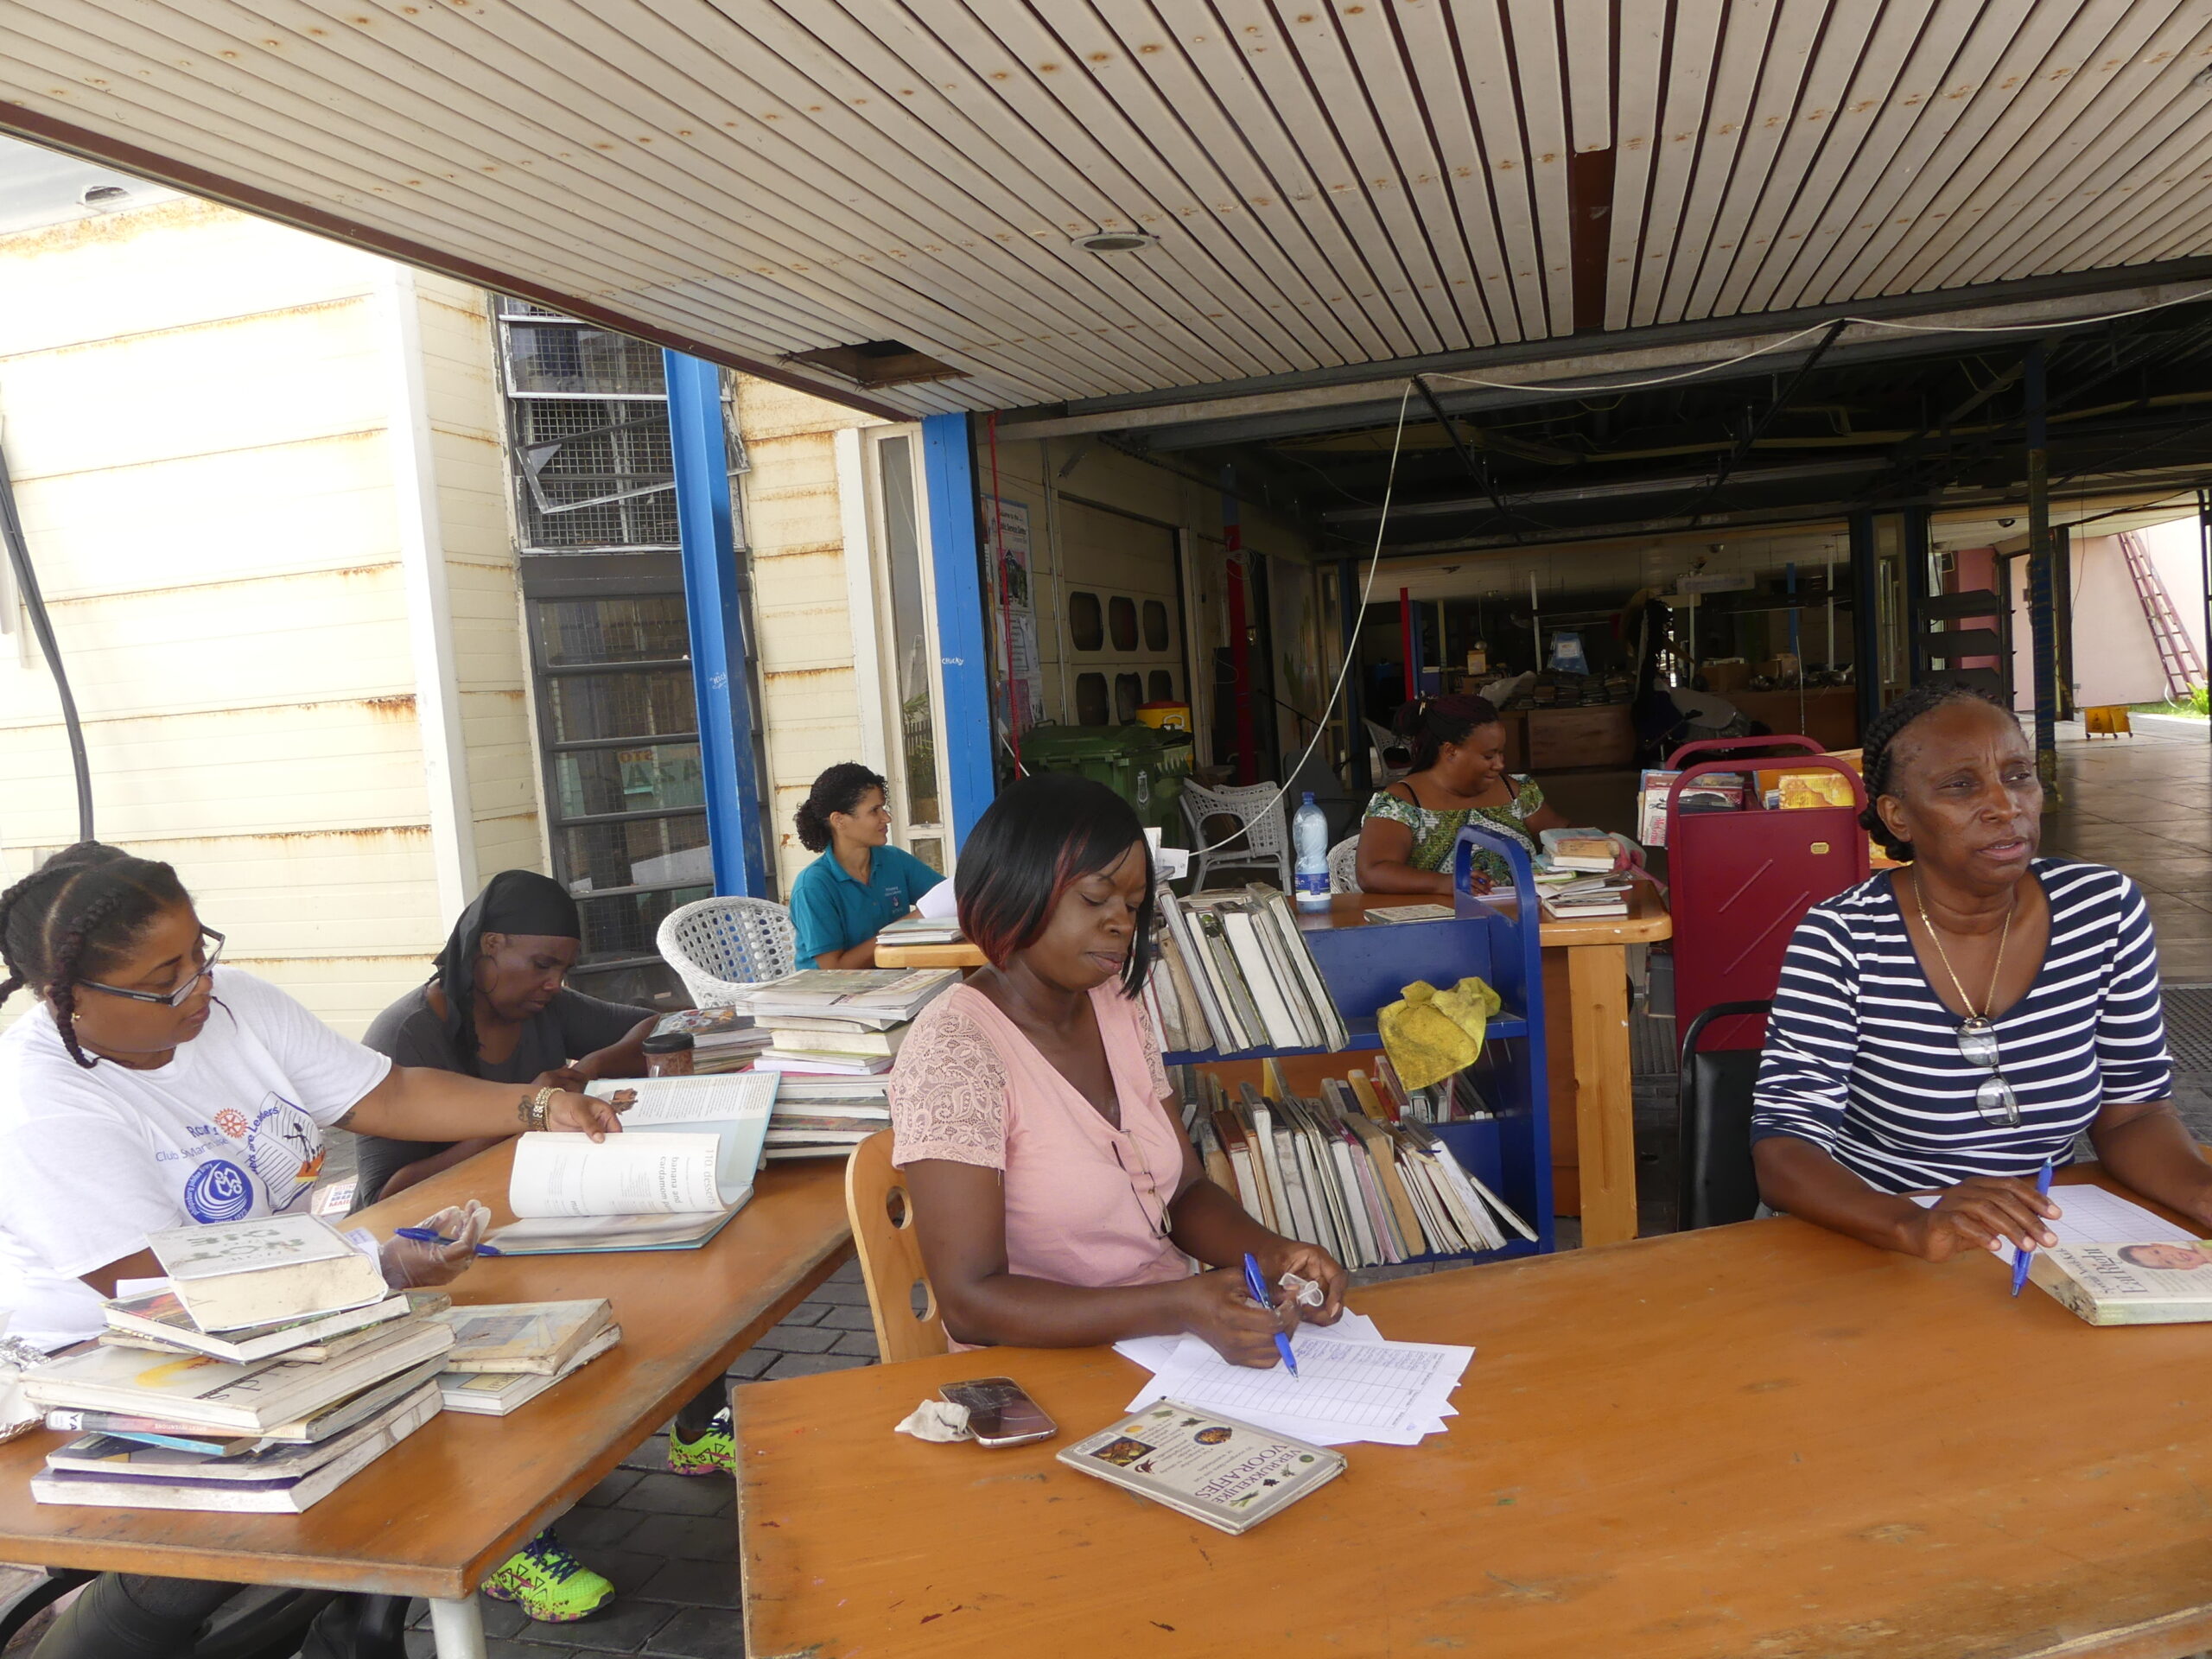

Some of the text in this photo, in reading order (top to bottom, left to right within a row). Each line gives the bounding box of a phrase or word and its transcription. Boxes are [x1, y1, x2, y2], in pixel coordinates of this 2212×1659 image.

[156, 1150, 179, 1162] Club
[658, 1156, 668, 1200] cardamom
[671, 1156, 680, 1189] banana
[1194, 1445, 1288, 1500] VOORAFJES
[1211, 1450, 1302, 1504] VERRUKKELIJKE
